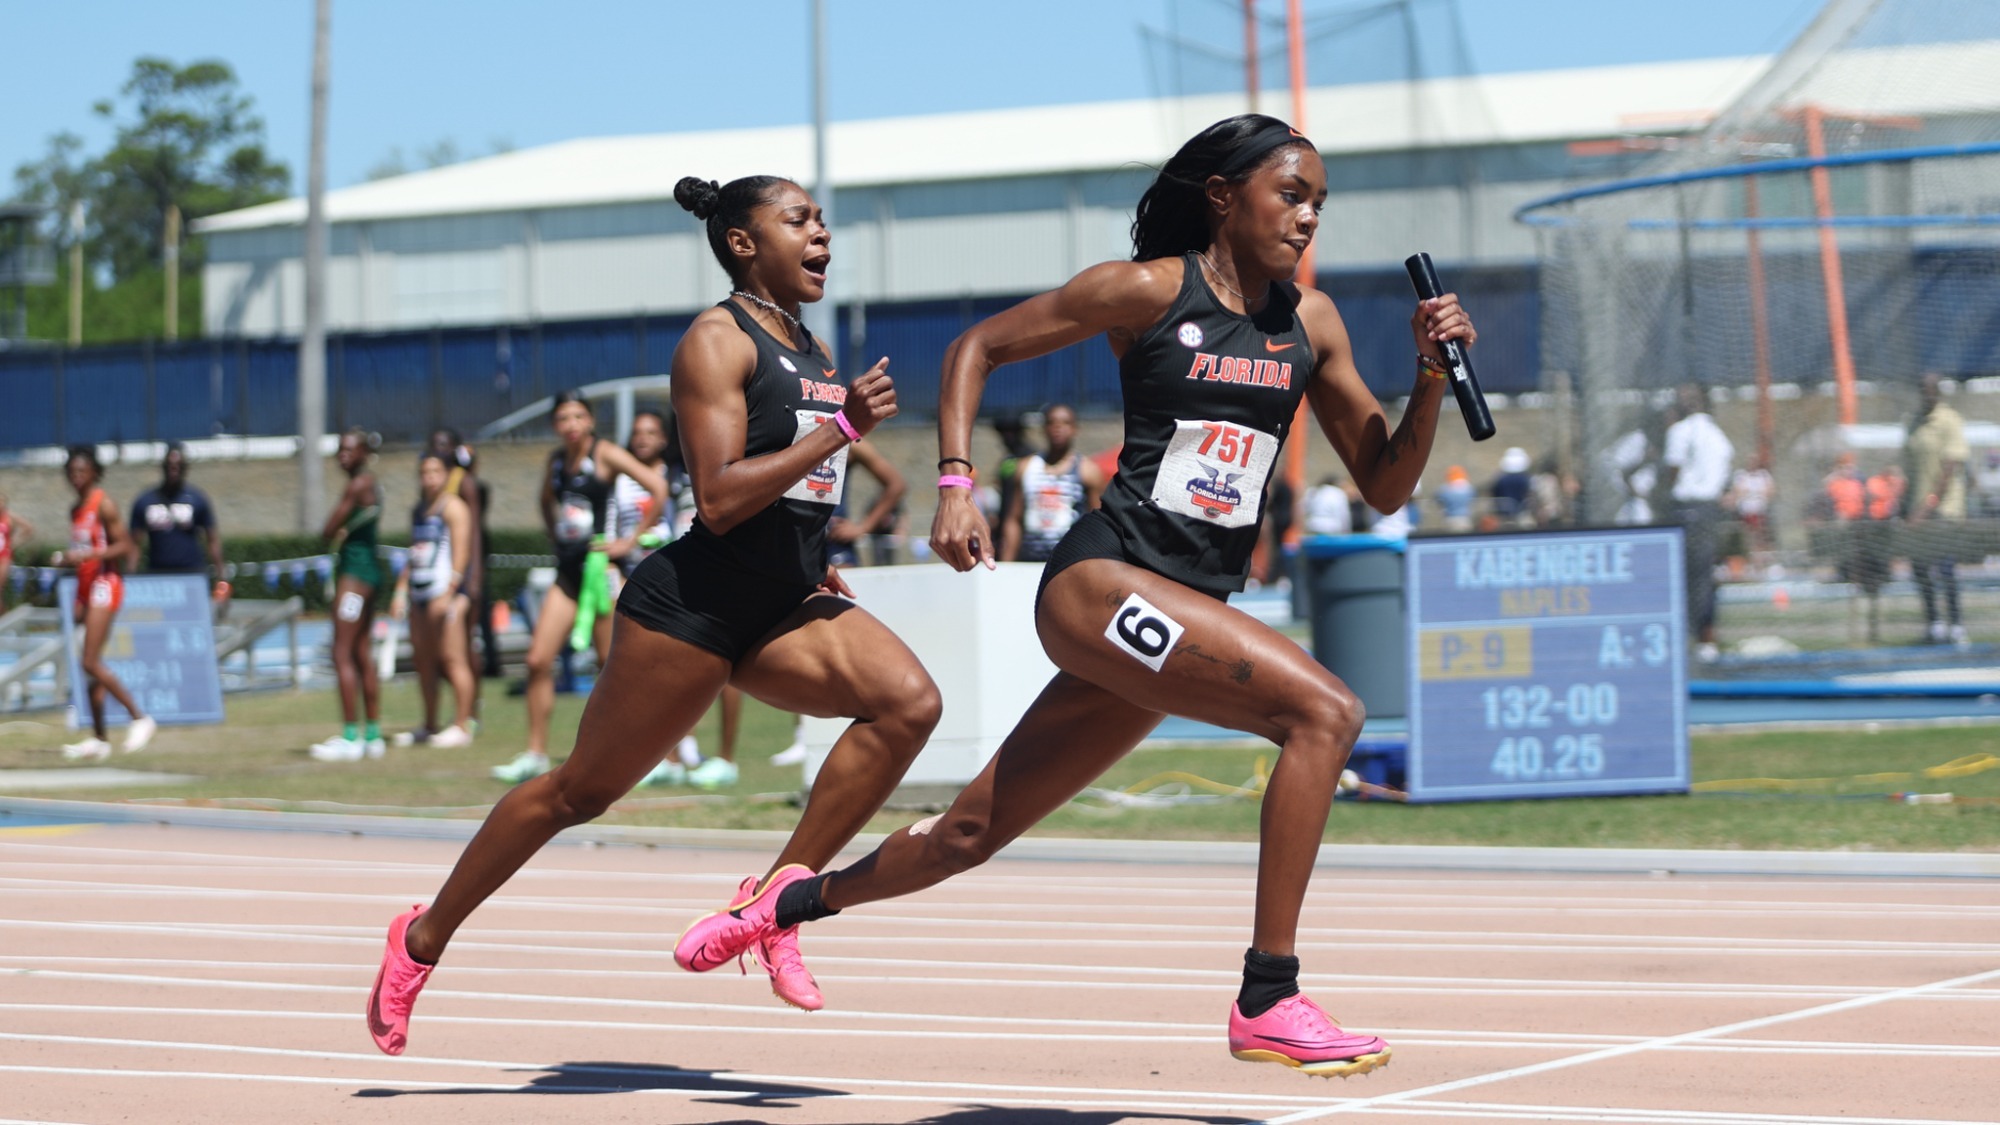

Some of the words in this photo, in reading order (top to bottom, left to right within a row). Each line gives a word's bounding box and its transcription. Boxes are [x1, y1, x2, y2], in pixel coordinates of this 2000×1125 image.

[1186, 352, 1292, 390] FLORIDA
[1197, 422, 1255, 468] 751
[1190, 484, 1217, 500] FLORIDA
[1218, 495, 1238, 504] RELAYS
[1454, 542, 1633, 588] KABENGELE
[1502, 585, 1591, 616] NAPLES
[1116, 606, 1171, 657] 6
[1484, 632, 1505, 671] 9
[1599, 625, 1634, 668] A:
[1643, 623, 1668, 666] 3
[1482, 682, 1619, 730] 132-00
[1490, 734, 1605, 779] 40.25
